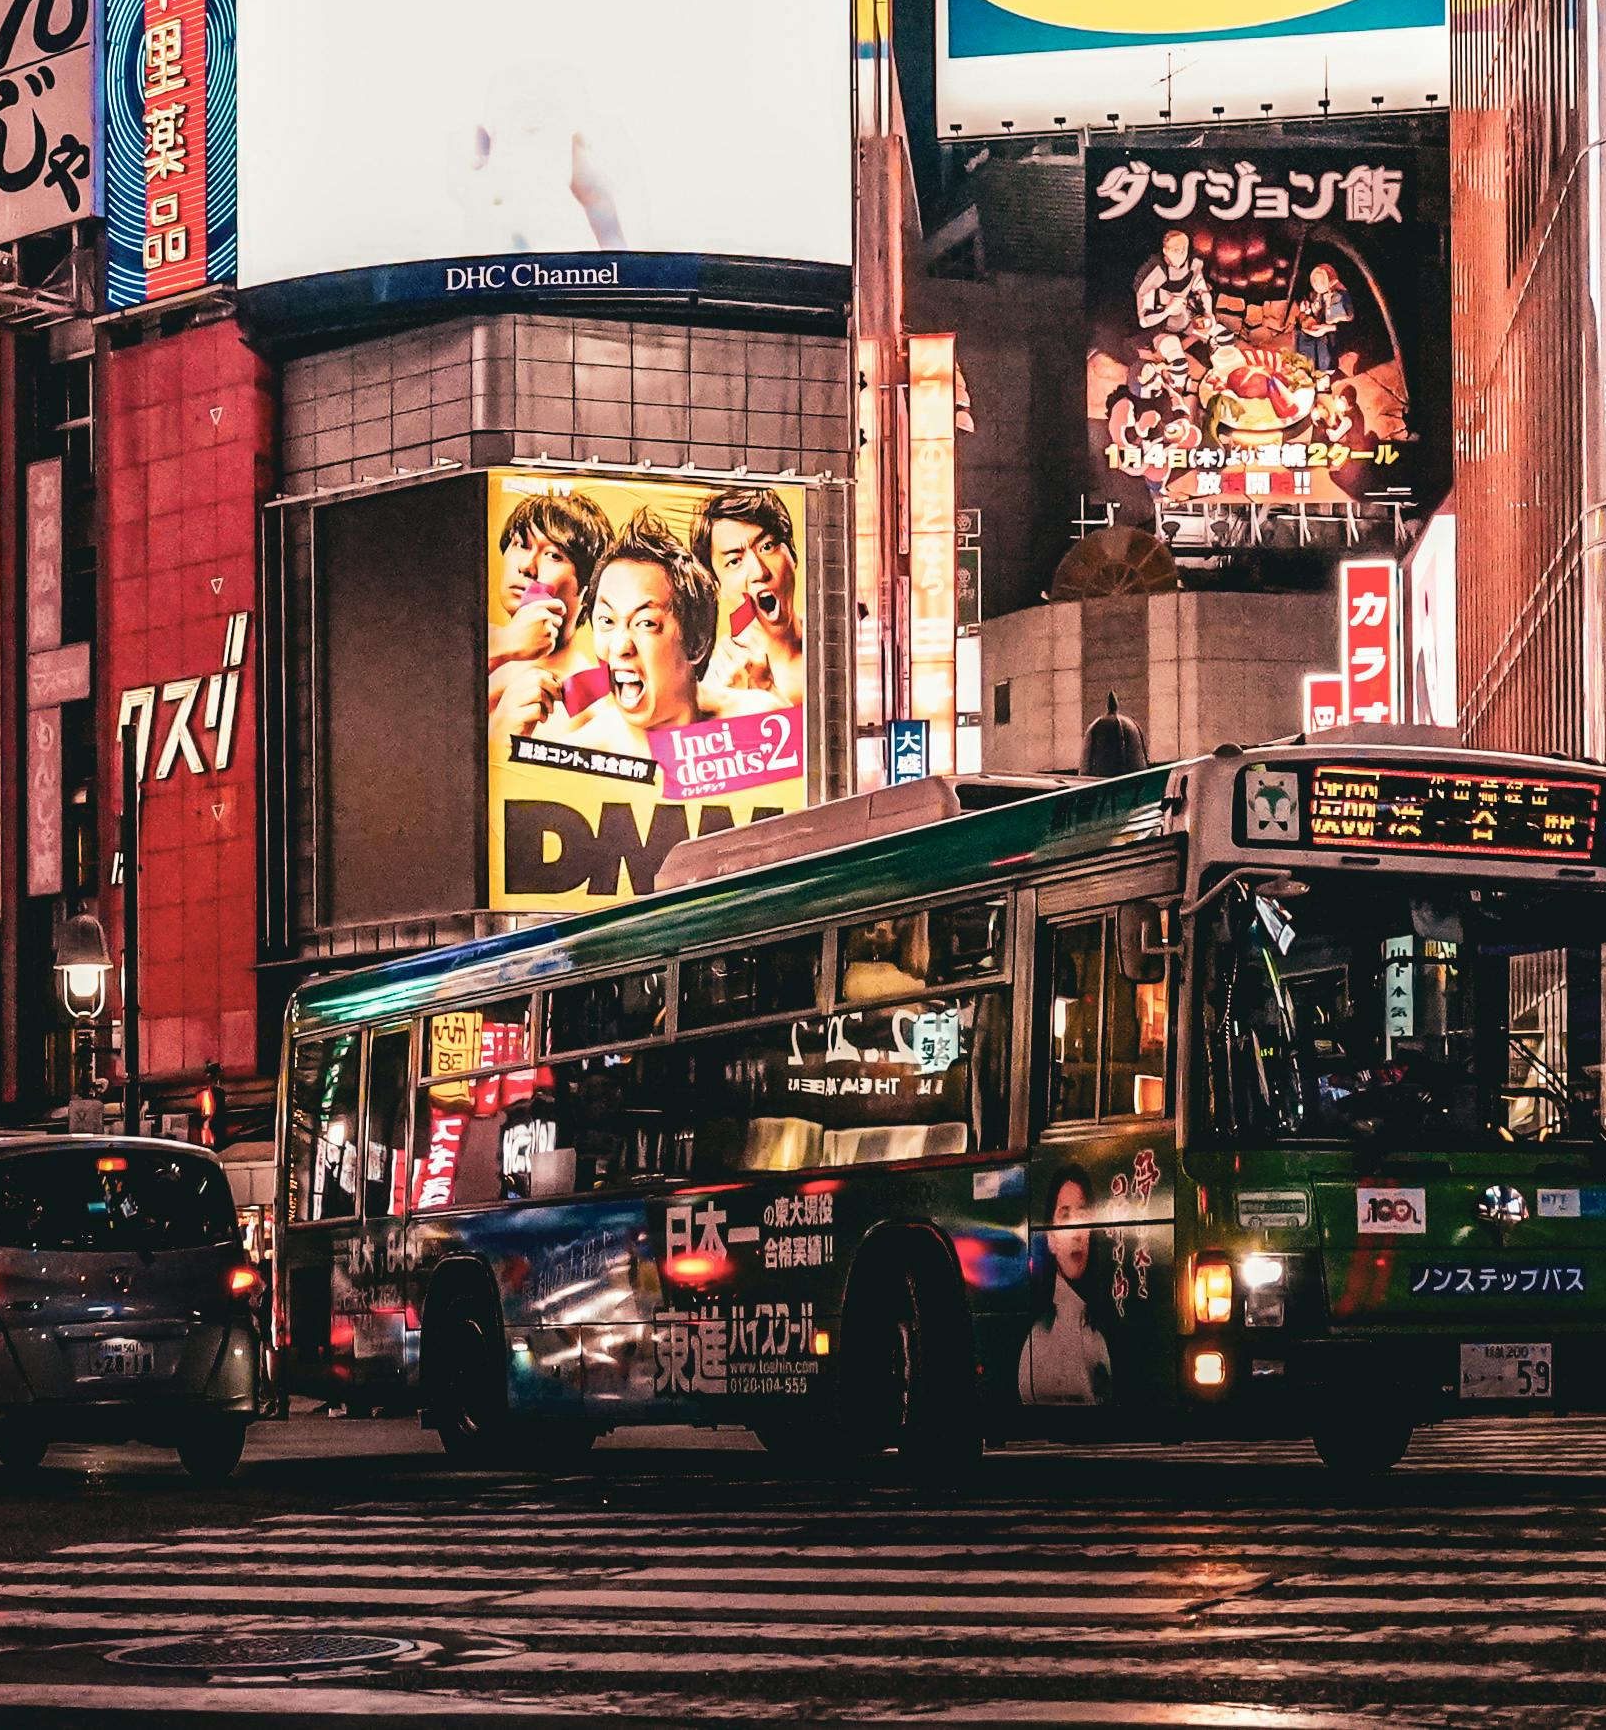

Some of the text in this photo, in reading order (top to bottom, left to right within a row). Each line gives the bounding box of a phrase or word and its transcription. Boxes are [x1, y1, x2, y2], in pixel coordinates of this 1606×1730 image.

[1096, 159, 1404, 224] ダンジョン飯
[446, 260, 620, 292] DHC Channel
[116, 670, 240, 781] クスリ
[672, 721, 735, 761] Inci
[666, 1200, 761, 1272] 日本一
[1412, 1267, 1585, 1293] ノンステップバス
[654, 1303, 728, 1395] 東進
[1517, 1359, 1552, 1396] 59
